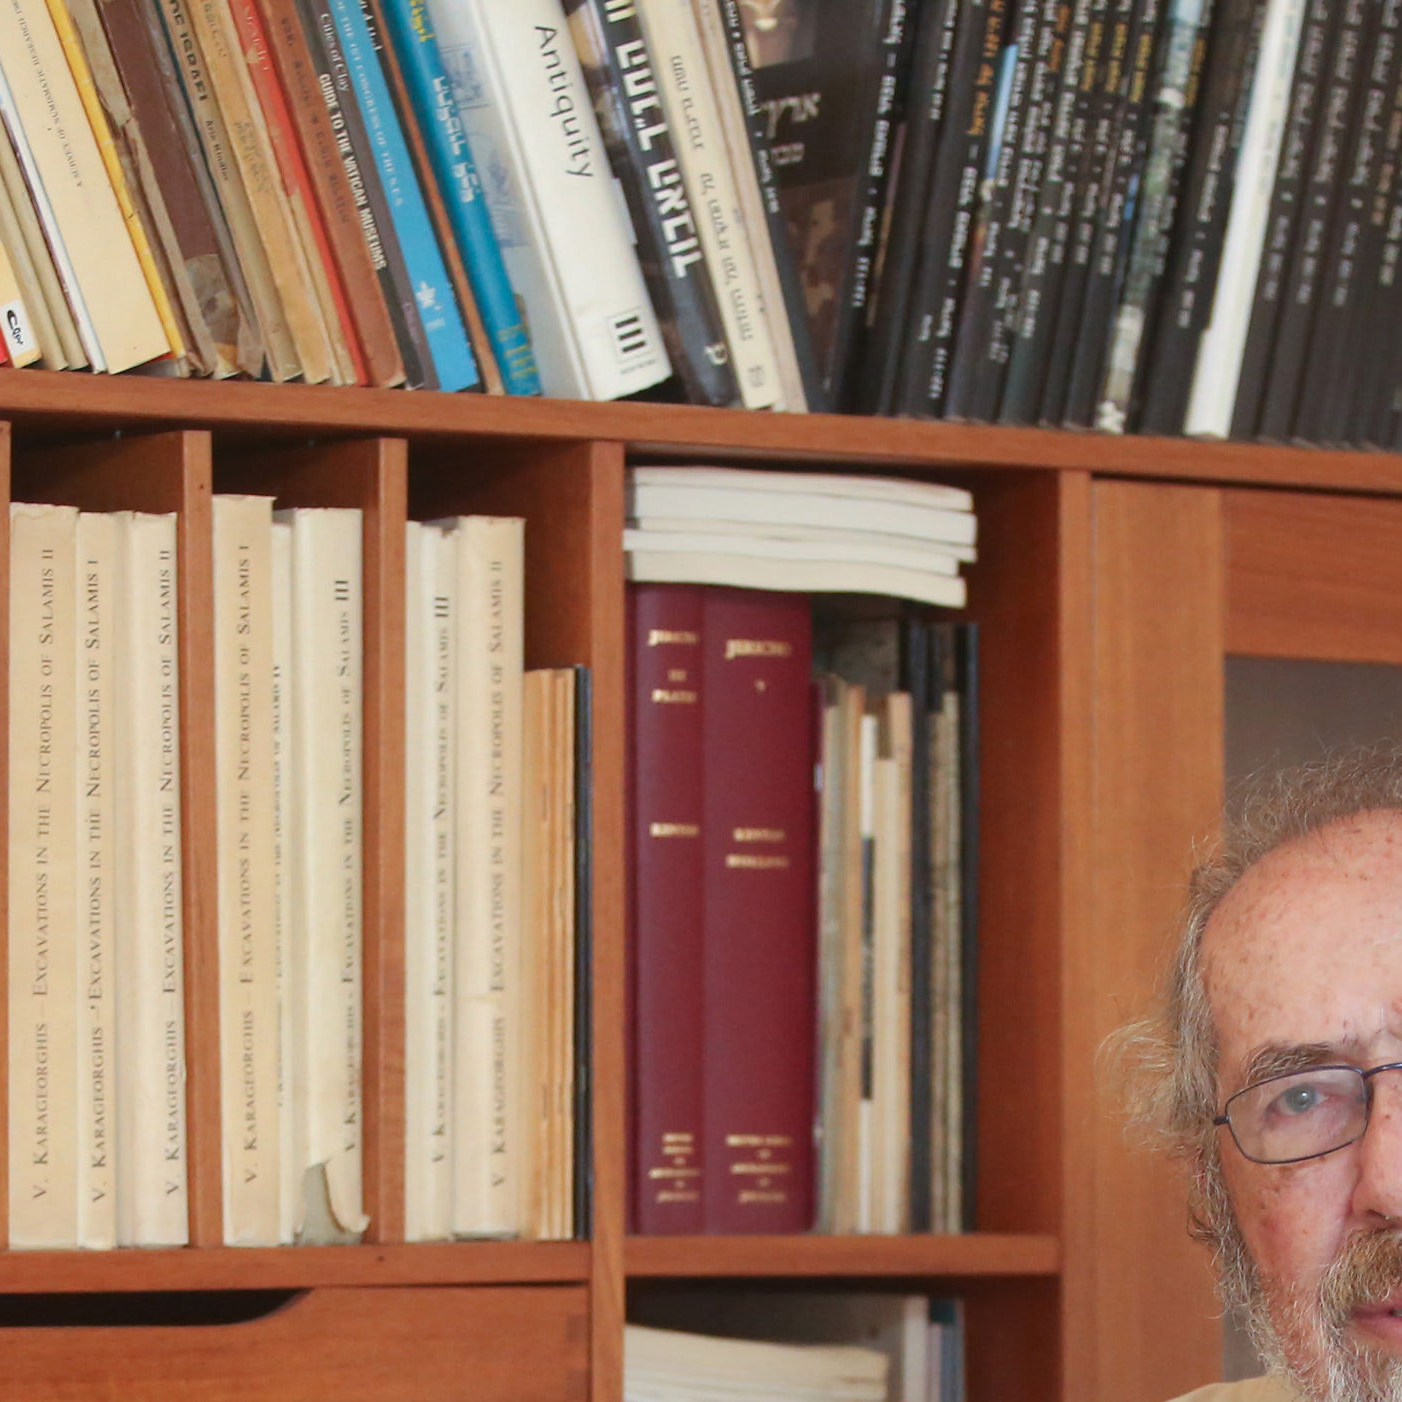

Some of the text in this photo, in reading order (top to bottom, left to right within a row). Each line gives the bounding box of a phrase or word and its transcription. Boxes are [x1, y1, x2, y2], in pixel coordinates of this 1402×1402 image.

[320, 13, 352, 93] Cities Clay
[37, 70, 59, 123] NUMISMATIC
[536, 26, 590, 176] Antiquity
[63, 143, 78, 178] SURVEY
[319, 72, 386, 269] GUIDE TO THE VATICAN MUSEUMS
[649, 161, 698, 275] האבוד
[86, 573, 99, 648] SALAMIS
[238, 558, 249, 633] SALAMIS
[88, 664, 99, 680] OF
[239, 647, 249, 664] OF
[86, 689, 99, 796] NECROPOLIS
[237, 673, 250, 779] NECROPOLIS
[89, 813, 100, 839] THE
[239, 794, 249, 821] THE
[239, 832, 249, 849] IN
[33, 549, 53, 1198] V. KARAGEORGHIS EXCAVATIONS IN THE NECROPOLIS OF SALAMIS II
[89, 850, 100, 868] IN
[88, 877, 101, 998] EXCAVATIONS
[238, 858, 252, 982] EXCAVATIONS
[92, 1027, 105, 1167] KARAGEORGHIS
[243, 1011, 256, 1150] KARAGEORGHIS
[91, 1178, 105, 1202] V.
